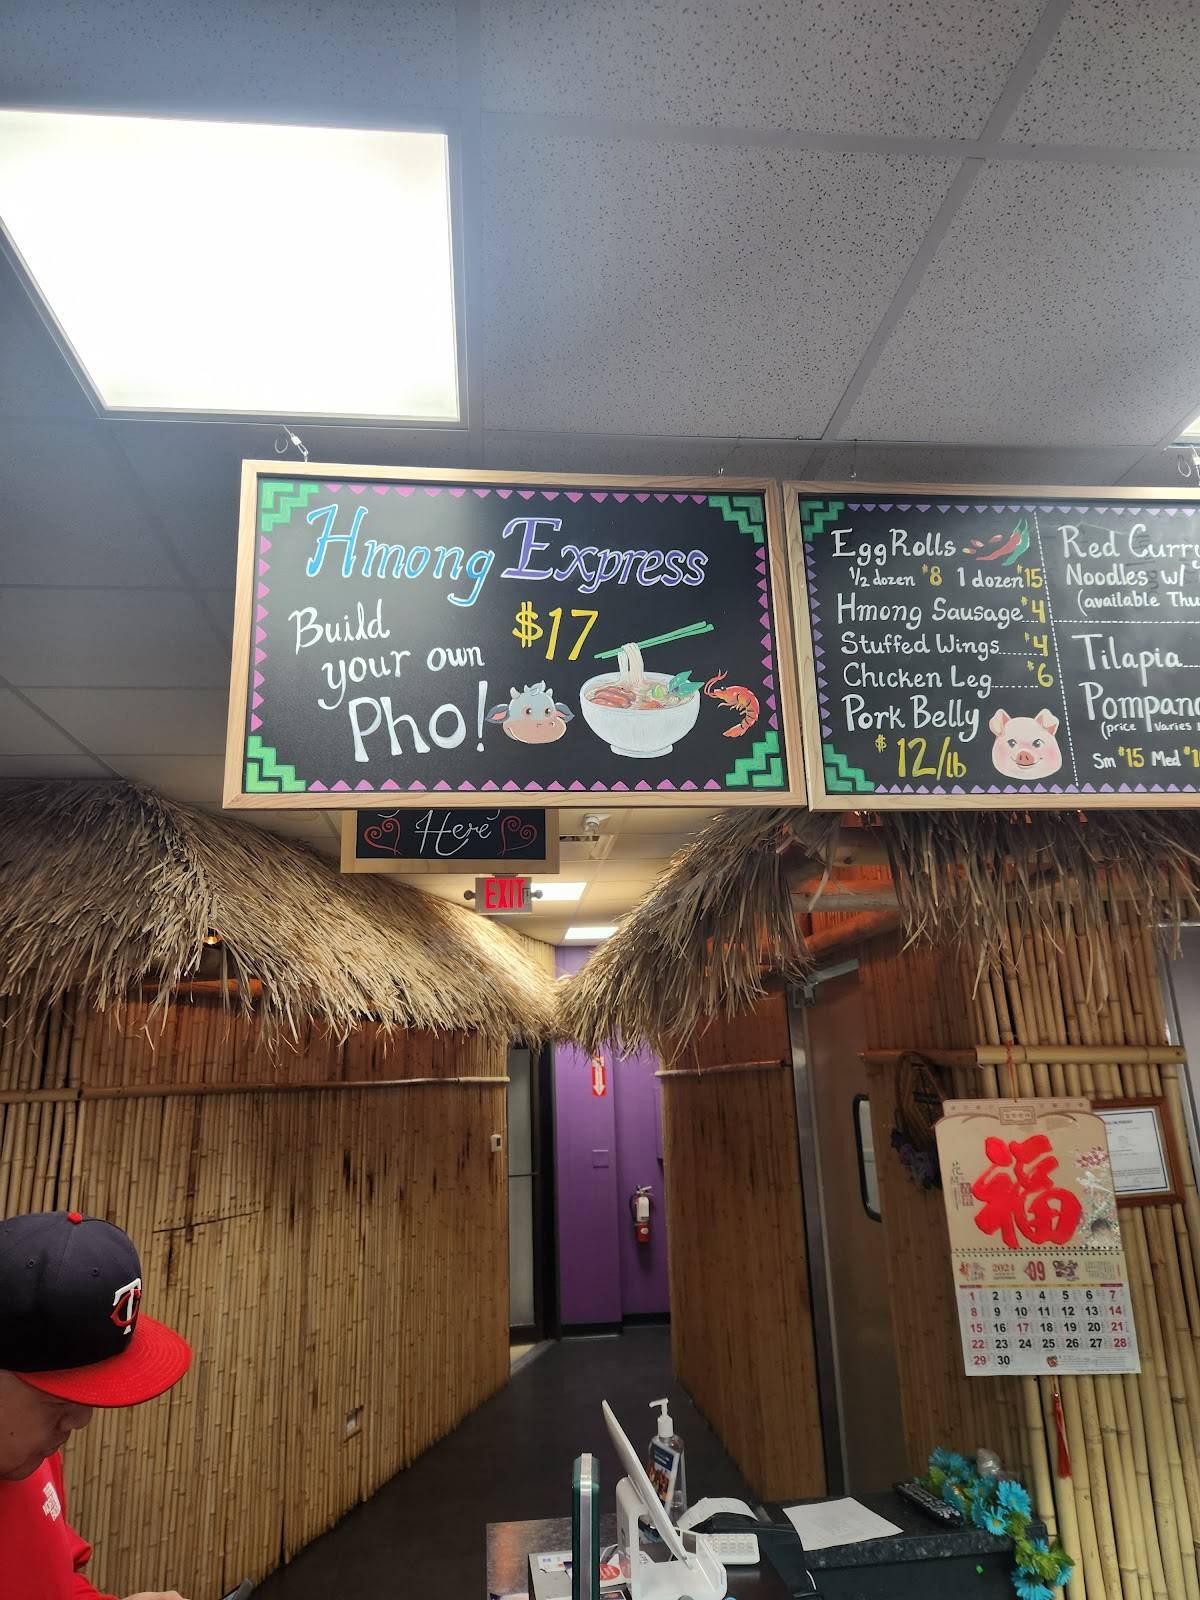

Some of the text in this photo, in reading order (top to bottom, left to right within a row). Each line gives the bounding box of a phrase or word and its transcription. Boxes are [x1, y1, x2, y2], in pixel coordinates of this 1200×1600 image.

[306, 504, 709, 607] Hmong Express
[831, 528, 957, 566] Egg Rolls
[1058, 525, 1120, 558] Red
[873, 569, 916, 586] dozen
[957, 567, 965, 587] 1
[972, 567, 1024, 588] dozen
[1066, 563, 1185, 586] Noodles w/
[837, 592, 922, 630] Hmong
[932, 597, 1024, 629] Sausage
[1078, 589, 1160, 616] (available
[288, 599, 390, 655] Build
[512, 601, 599, 662] $17
[841, 631, 930, 655] Stuffed
[936, 634, 999, 662] Wings
[1072, 634, 1183, 687] Tilapia
[318, 645, 485, 710] your own
[843, 662, 942, 689] Chicken
[950, 665, 992, 699] Leg
[348, 680, 489, 763] Pho!
[840, 694, 980, 743] Pork Belly
[1101, 721, 1136, 740] (price
[1092, 753, 1116, 769] Sm
[1152, 749, 1181, 766] Med
[414, 810, 492, 856] Here
[485, 878, 525, 909] EXIT
[971, 1133, 1083, 1250] 福
[970, 1291, 1115, 1300] 1 2 3 4 5 6 7
[971, 1306, 1122, 1316] 8 9 10 11 12 13 14
[971, 1322, 1123, 1333] 15 16 17 18 19 20 21
[972, 1338, 1127, 1349] 22 23 24 25 26 27 28
[974, 1356, 1010, 1365] 29 30
